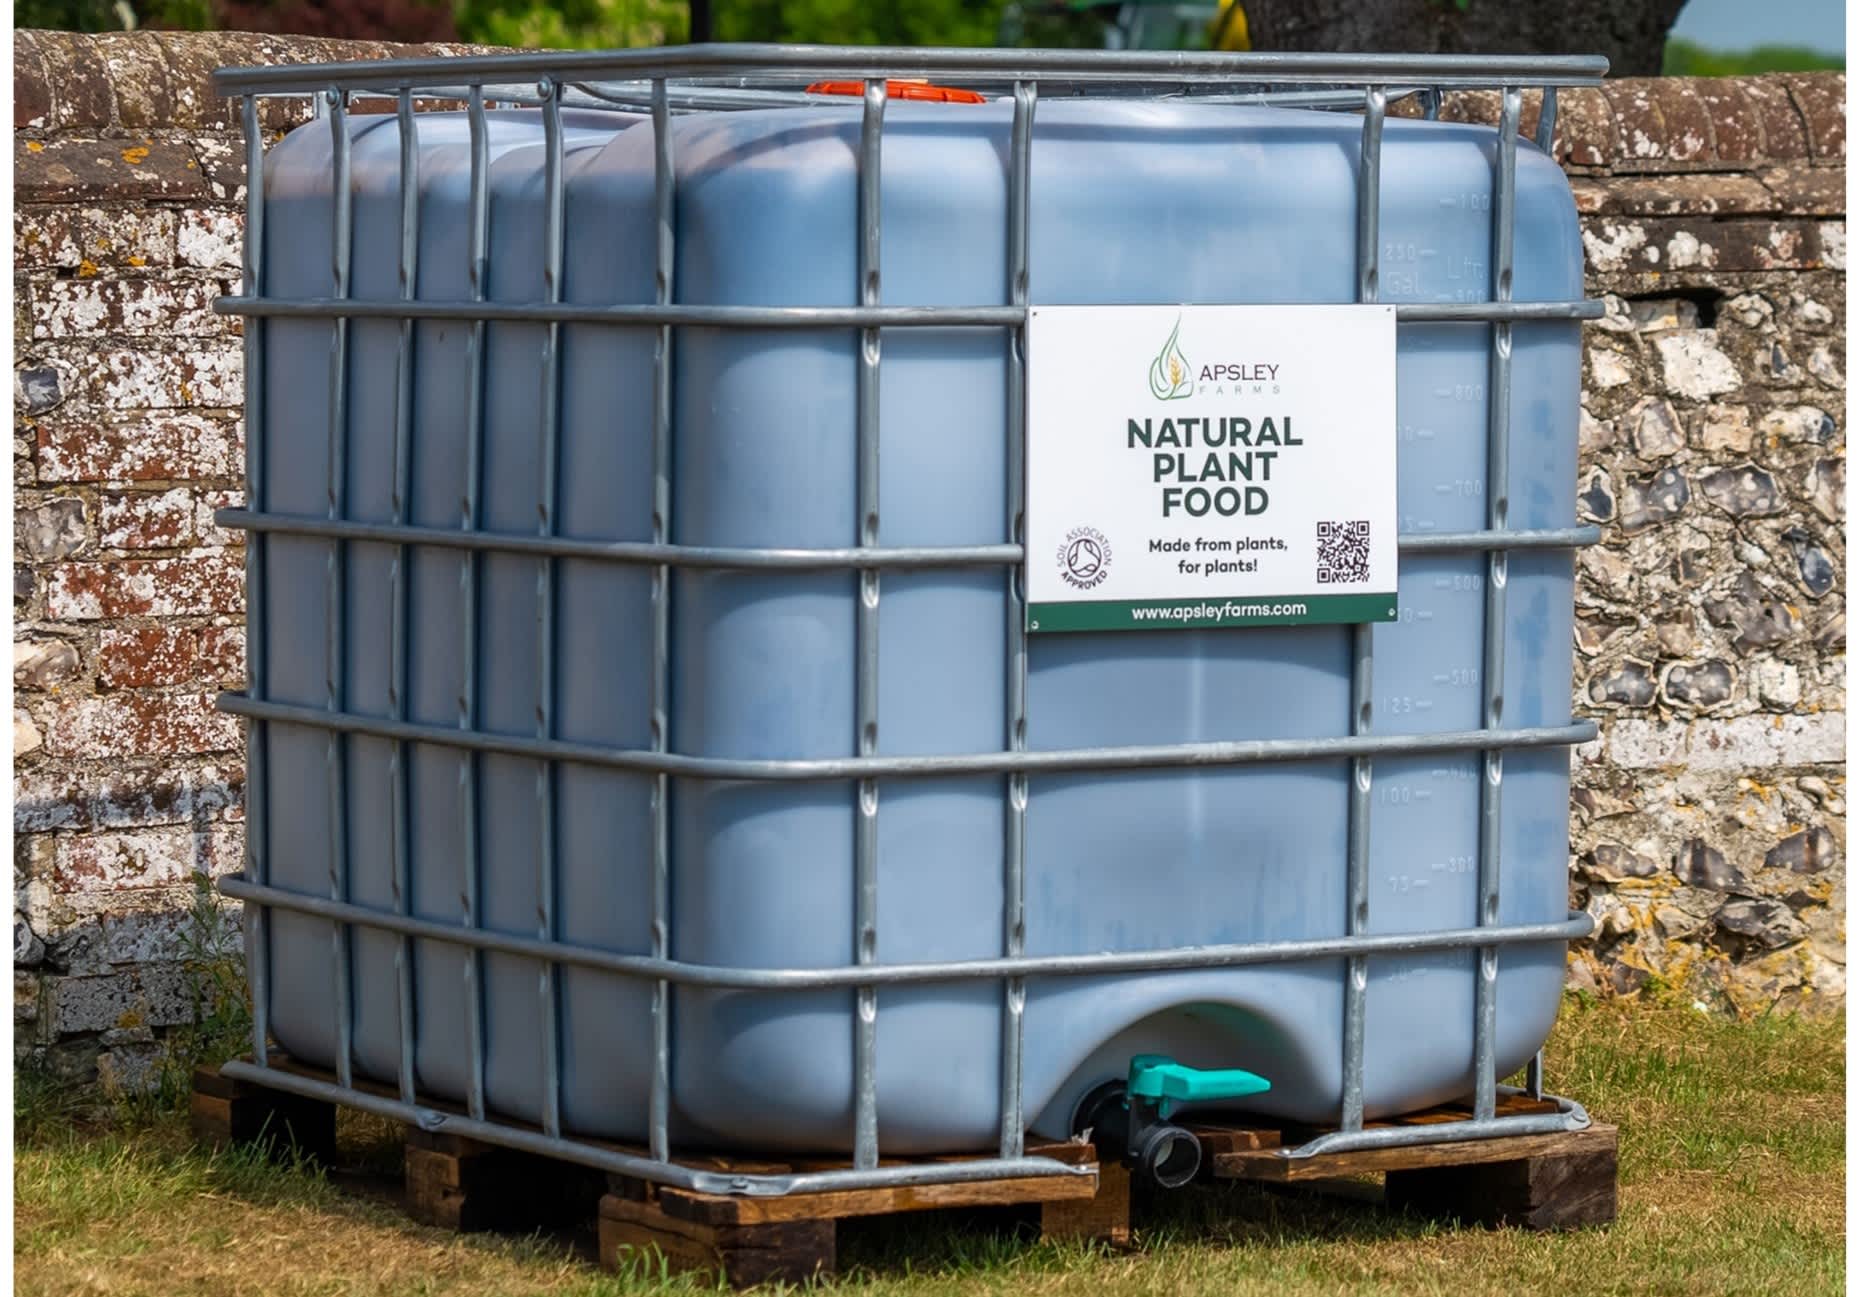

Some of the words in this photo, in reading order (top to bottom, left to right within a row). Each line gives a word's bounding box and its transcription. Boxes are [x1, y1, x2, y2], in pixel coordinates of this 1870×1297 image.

[1199, 364, 1280, 381] APSLEY
[1199, 385, 1280, 395] FARMS
[1454, 384, 1484, 401] 800
[1127, 416, 1304, 448] NATURAL
[1153, 451, 1278, 483] PLANT
[1454, 479, 1482, 496] 700
[1162, 486, 1269, 518] FOOD
[1056, 544, 1068, 568] SOIL
[1066, 526, 1112, 566] ASSOCIATION
[1149, 537, 1191, 553] Made
[1194, 537, 1232, 552] from
[1236, 535, 1288, 556] plants,
[1178, 559, 1201, 575] for
[1204, 558, 1258, 577] plants!
[1061, 570, 1107, 589] APPROVED
[1132, 602, 1307, 622] www.apsleyfarms.com
[1451, 668, 1478, 685] 500
